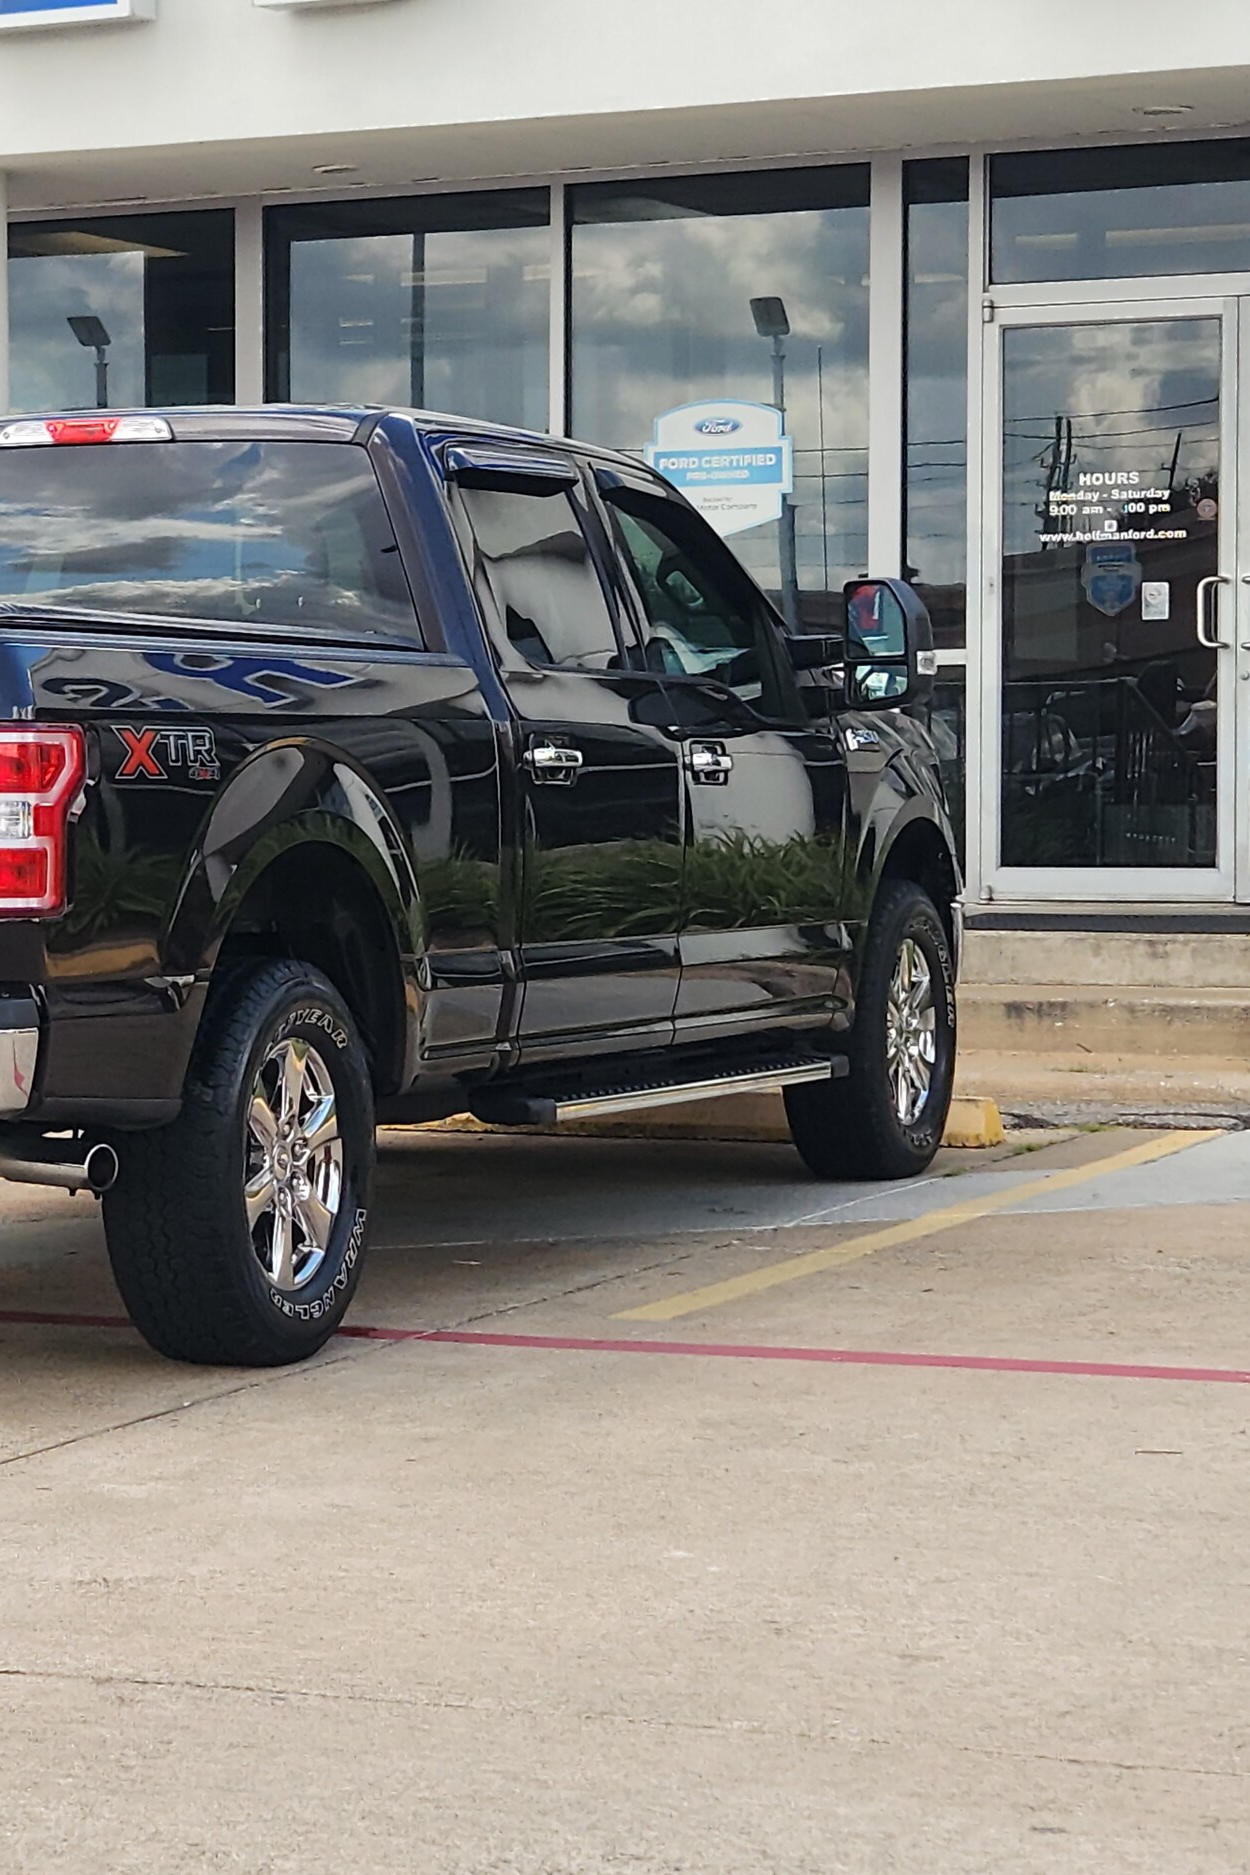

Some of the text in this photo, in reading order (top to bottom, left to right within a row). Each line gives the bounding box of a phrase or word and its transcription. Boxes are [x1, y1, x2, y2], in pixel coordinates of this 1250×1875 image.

[702, 419, 733, 433] Ford
[659, 453, 776, 470] FORD CERTIFIED
[1079, 472, 1139, 486] HOURS
[1049, 490, 1100, 502] Monday
[1111, 488, 1170, 500] Saturday
[1082, 506, 1103, 514] am
[1148, 503, 1171, 514] pm
[270, 1208, 367, 1320] WRANGLER
